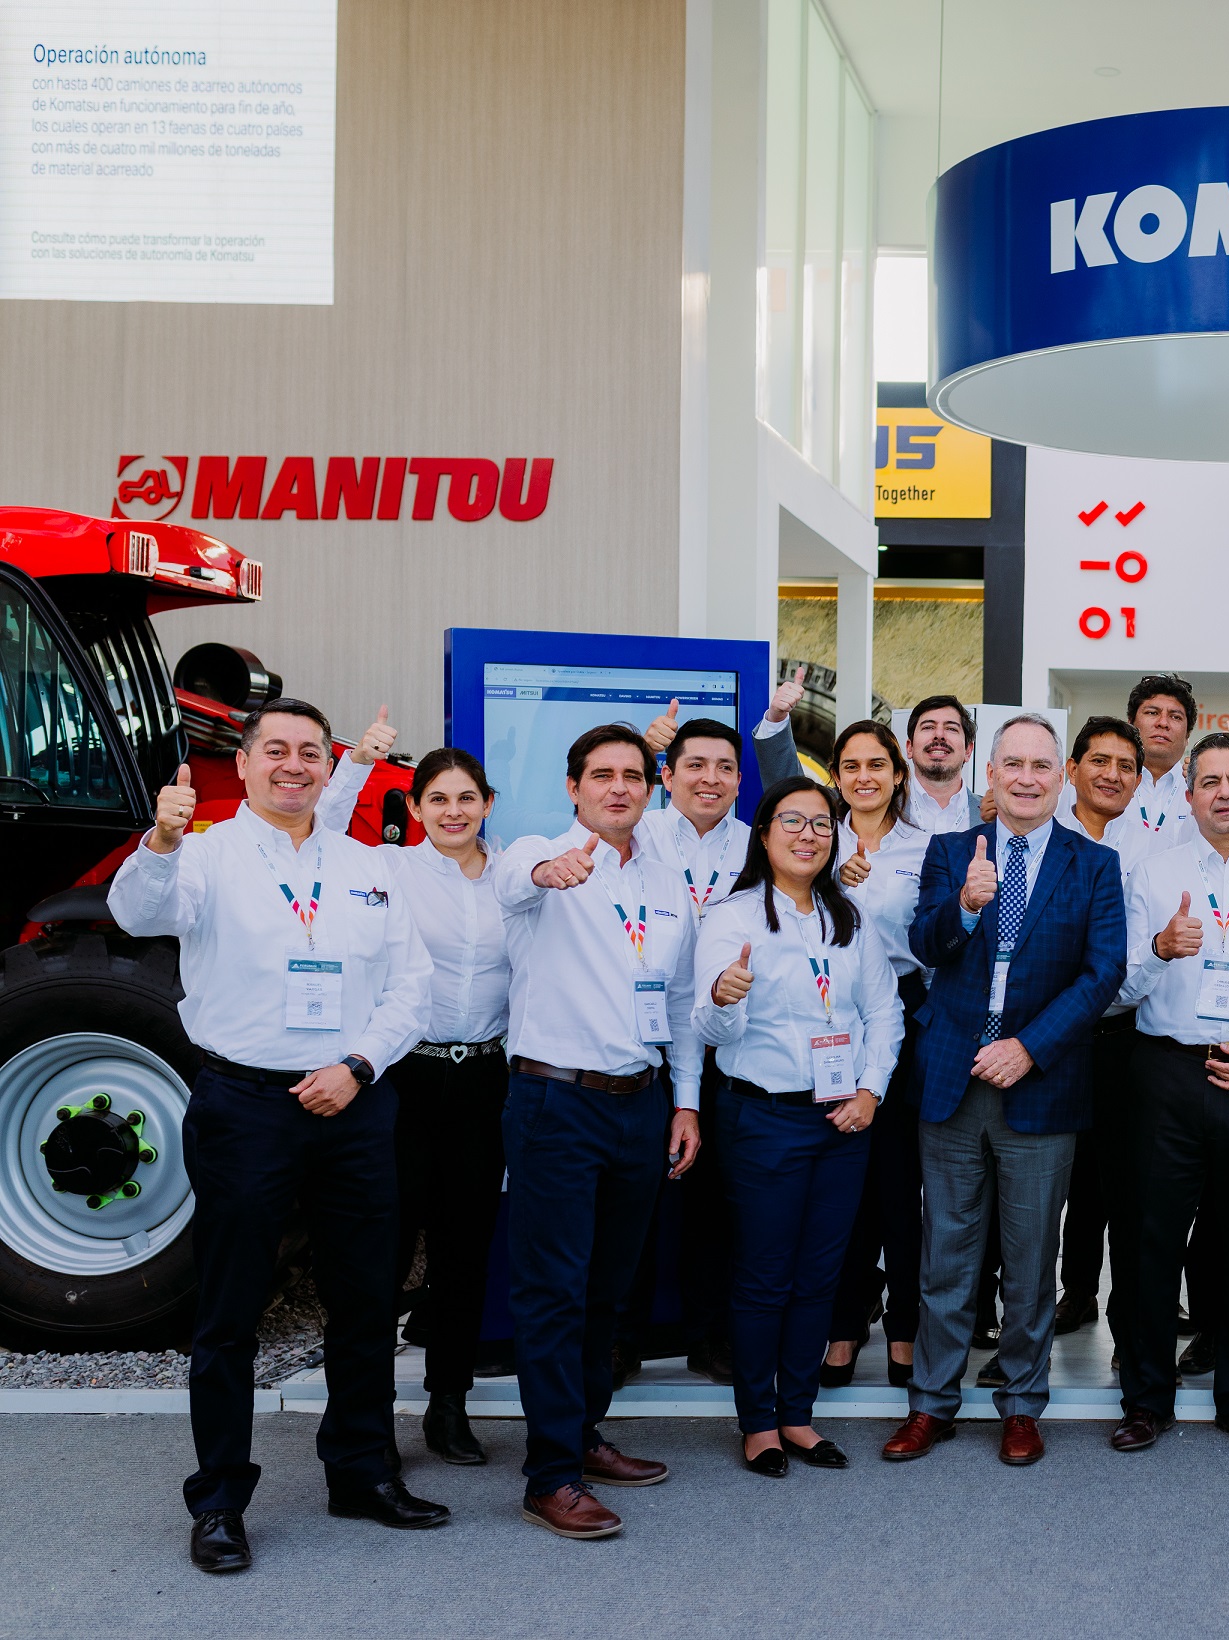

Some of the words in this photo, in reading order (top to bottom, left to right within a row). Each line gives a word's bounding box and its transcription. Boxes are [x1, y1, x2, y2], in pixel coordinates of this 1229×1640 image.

[33, 43, 119, 68] Operación
[124, 45, 207, 65] autónoma
[32, 78, 54, 90] con
[57, 76, 88, 91] hasta
[91, 77, 114, 91] 400
[116, 78, 172, 92] camiones
[174, 79, 189, 93] de
[191, 80, 235, 93] acarreo
[238, 79, 302, 94] autónomos
[32, 97, 47, 111] de
[50, 97, 100, 112] Komatsu
[103, 100, 117, 113] en
[119, 98, 208, 114] funcionamiento
[210, 102, 236, 117] para
[239, 100, 252, 114] fin
[255, 101, 270, 115] de
[31, 118, 49, 132] los
[51, 119, 88, 133] cuales
[91, 121, 131, 136] operan
[134, 122, 148, 134] en
[152, 120, 166, 134] 13
[168, 120, 207, 135] faenas
[209, 122, 224, 135] de
[226, 122, 263, 136] cuatro
[266, 122, 303, 139] países
[31, 141, 53, 154] con
[56, 140, 80, 154] más
[82, 141, 97, 154] de
[100, 142, 137, 155] cuatro
[139, 141, 155, 156] mil
[158, 141, 205, 156] millones
[208, 141, 222, 156] de
[225, 143, 281, 157] toneladas
[31, 162, 46, 175] de
[48, 161, 93, 176] material
[96, 163, 154, 176] acarreado
[31, 231, 76, 244] Consulte
[78, 231, 107, 245] cómo
[109, 233, 141, 247] puede
[143, 234, 201, 247] transformar
[203, 234, 212, 247] la
[214, 234, 266, 248] operación
[31, 247, 50, 259] con
[52, 247, 67, 259] las
[69, 248, 122, 260] soluciones
[125, 248, 138, 261] de
[140, 249, 193, 261] autonomía
[195, 249, 208, 261] de
[210, 249, 255, 262] Komatsu
[191, 456, 554, 521] MANITOU
[876, 485, 936, 505] Together
